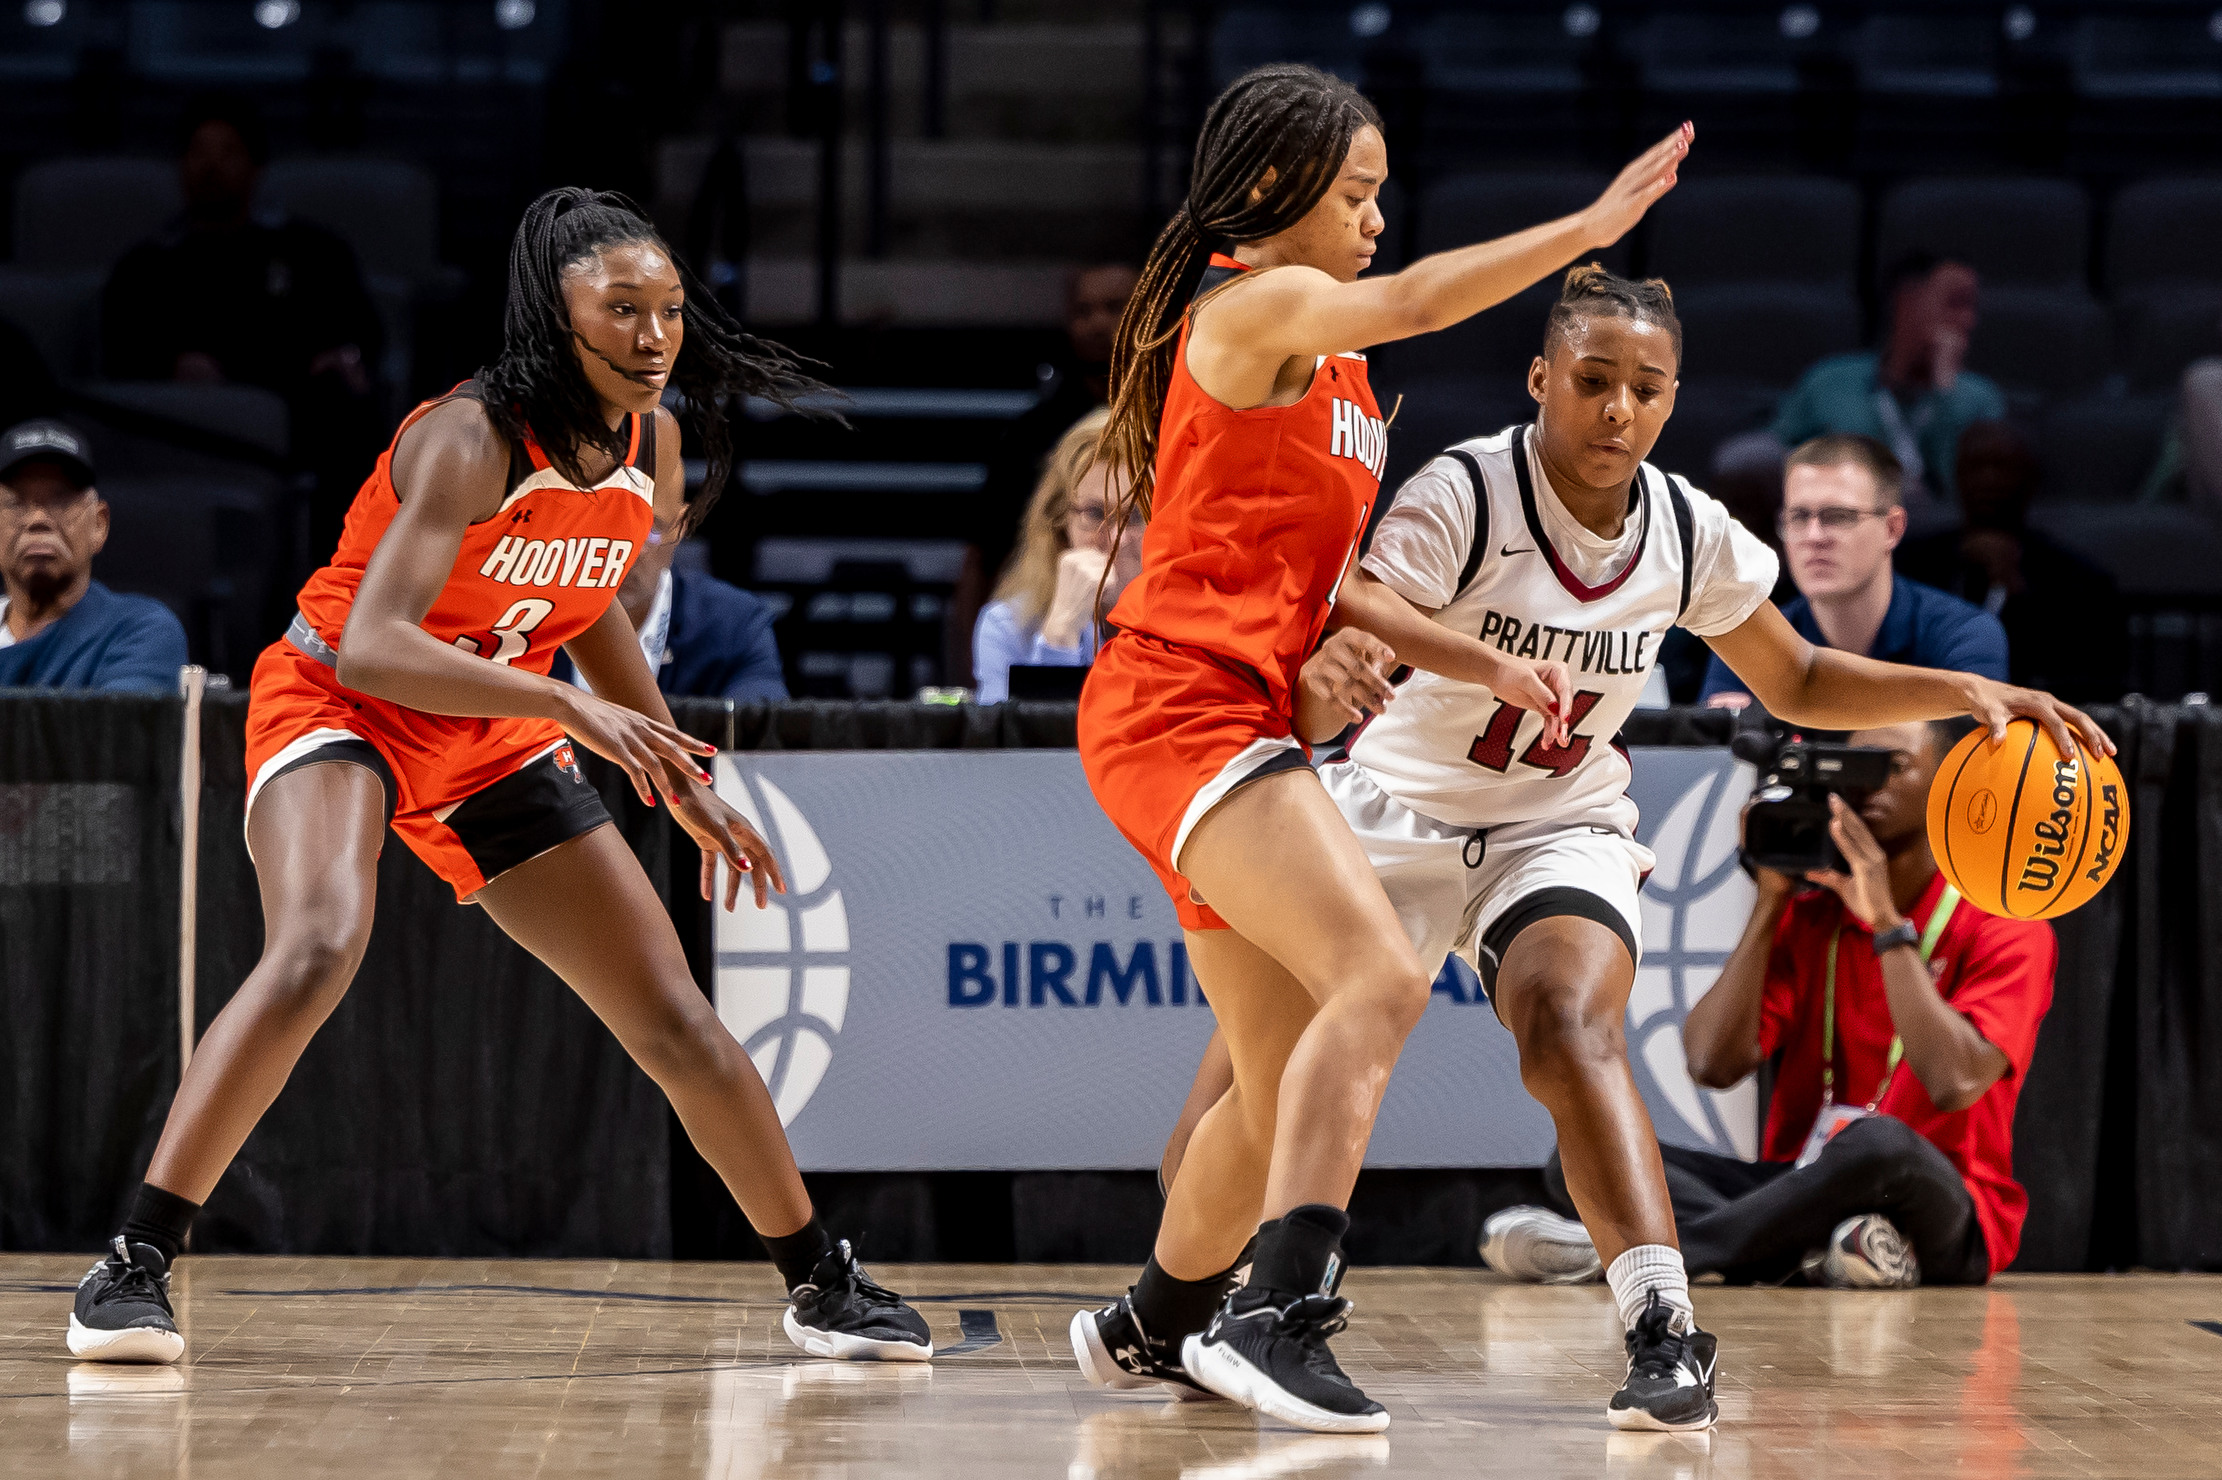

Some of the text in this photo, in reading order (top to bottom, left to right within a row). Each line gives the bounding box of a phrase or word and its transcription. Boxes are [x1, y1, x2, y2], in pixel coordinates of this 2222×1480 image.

[1330, 397, 1388, 482] HOOV
[479, 535, 633, 588] HOOVER
[453, 597, 555, 666] 3
[1479, 610, 1650, 675] PRATTVILLE
[2016, 758, 2079, 892] Wilson
[2086, 784, 2120, 883] NCAA
[1049, 895, 1144, 920] THE
[946, 940, 1488, 1008] BIRMIA
